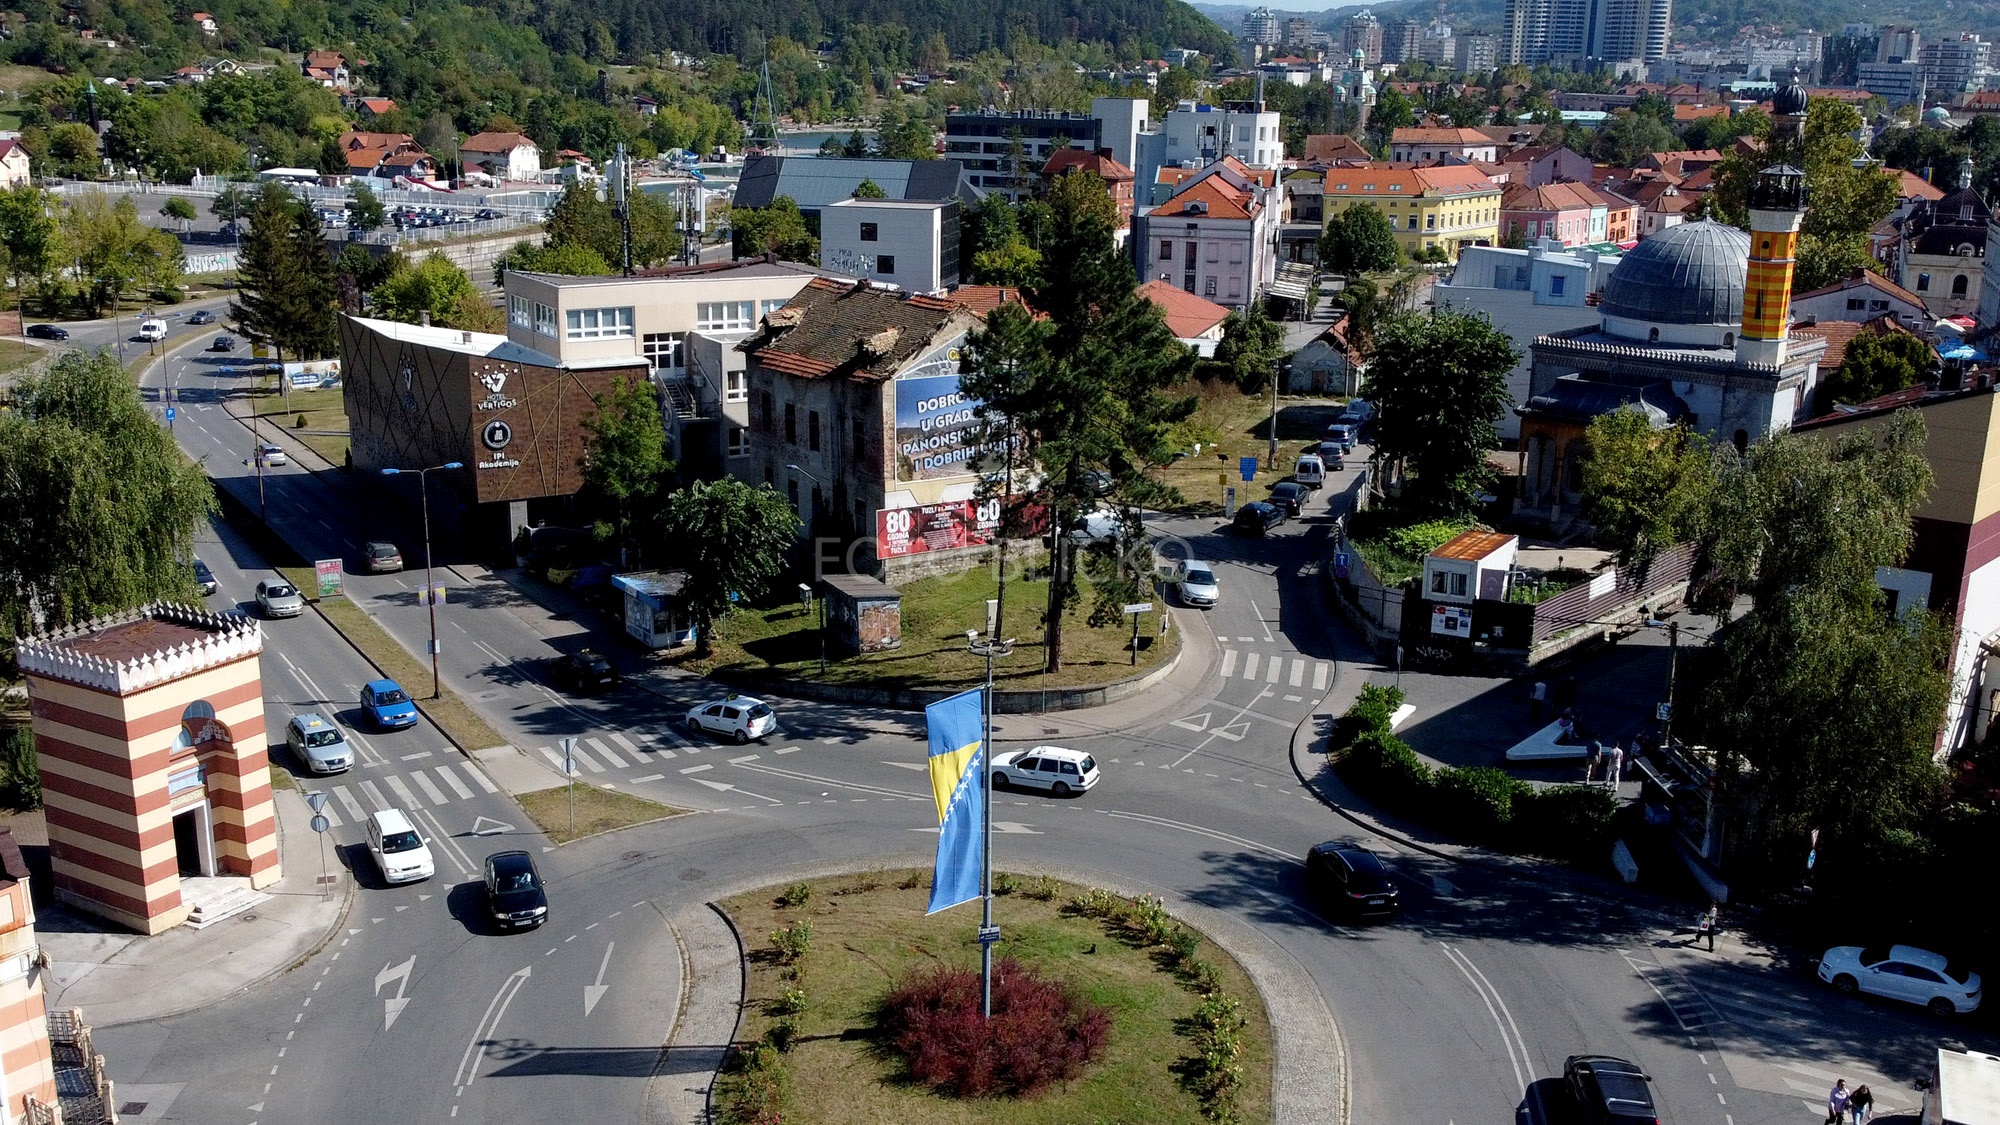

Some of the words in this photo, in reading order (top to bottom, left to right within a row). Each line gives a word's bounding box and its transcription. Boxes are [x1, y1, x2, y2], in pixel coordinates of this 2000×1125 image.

[478, 399, 516, 410] VERTIGOS
[920, 420, 931, 432] U
[493, 452, 505, 460] IPI
[914, 459, 920, 472] I
[924, 446, 976, 470] DOBRIH
[479, 460, 519, 469] Akademija
[886, 510, 910, 533] 80
[887, 532, 909, 541] GODINA
